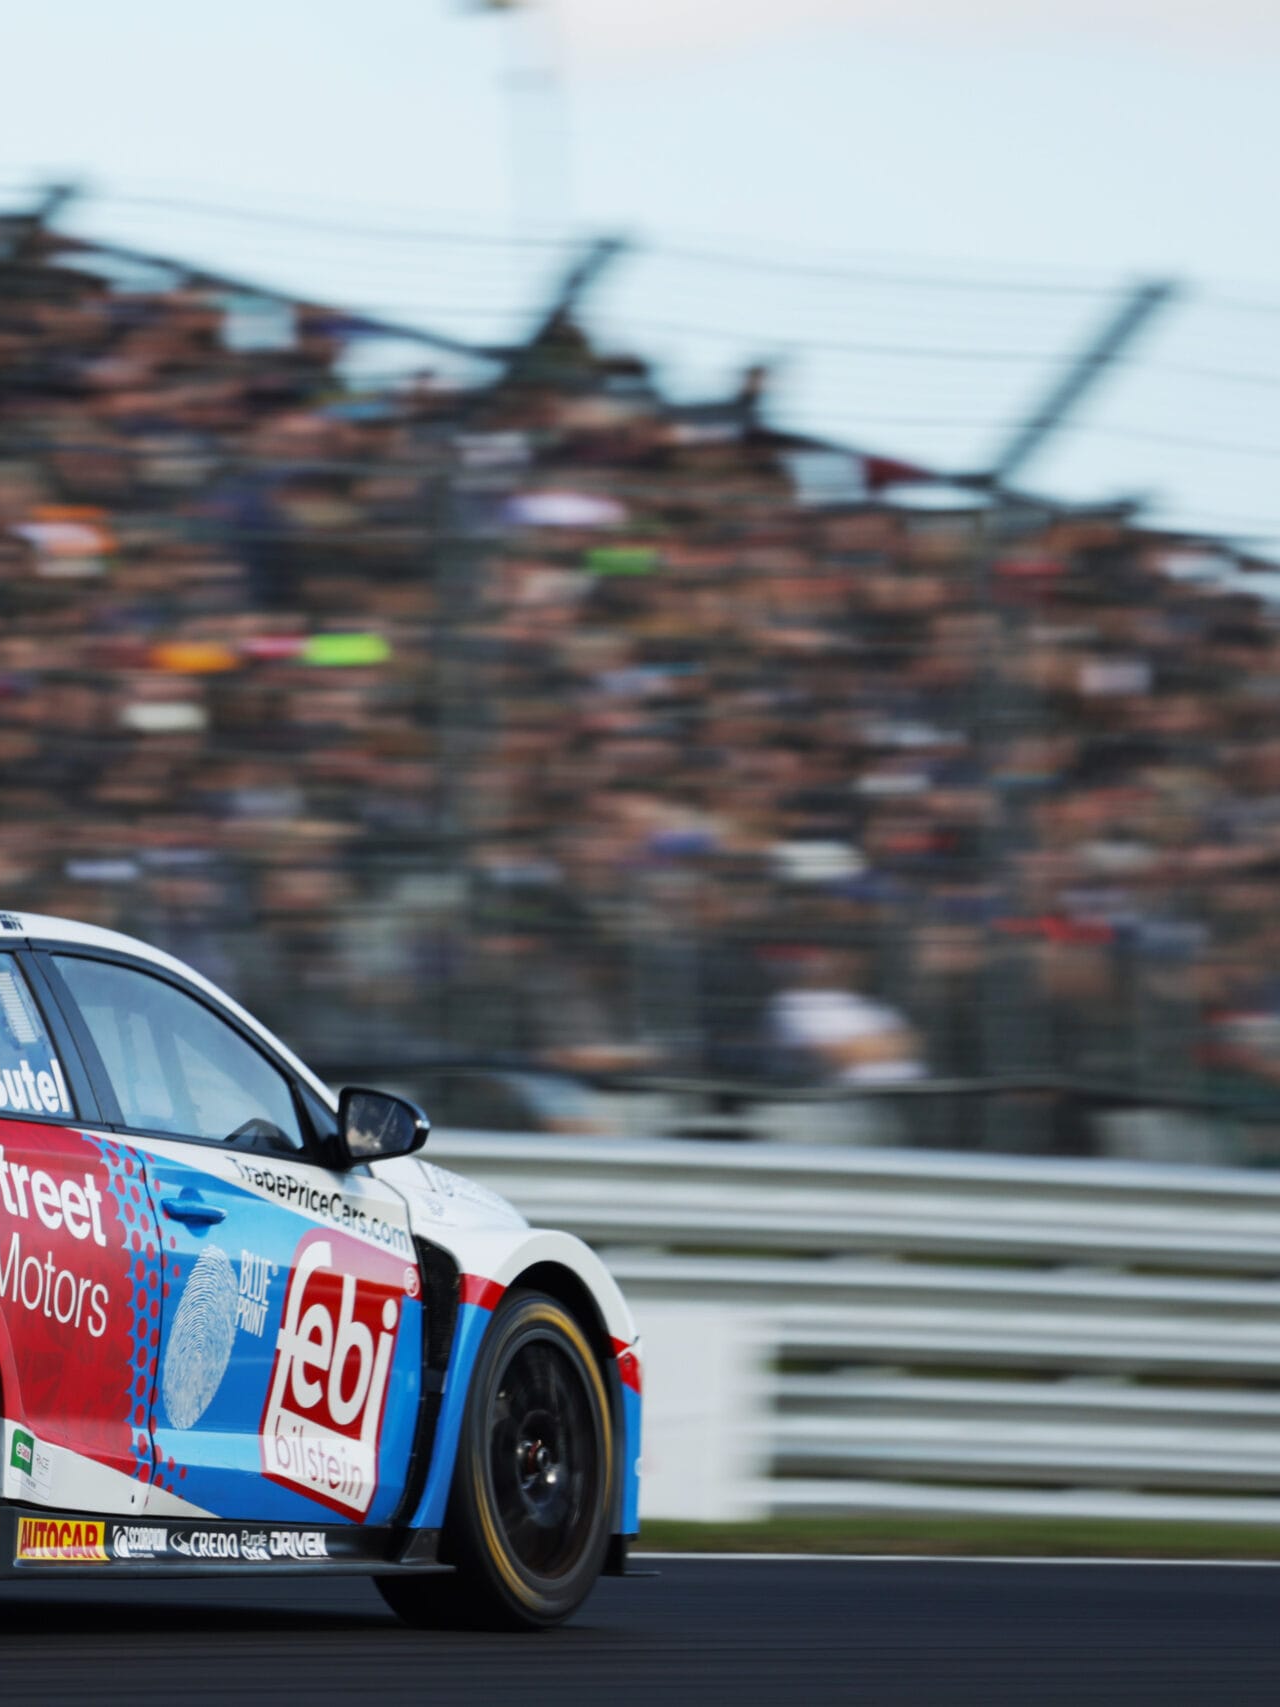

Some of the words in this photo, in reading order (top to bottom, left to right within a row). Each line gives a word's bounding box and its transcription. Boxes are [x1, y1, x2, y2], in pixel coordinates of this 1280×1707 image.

[225, 1157, 410, 1251] TradePriceCars.com
[239, 1249, 271, 1305] BLUE
[235, 1295, 269, 1338] PRINT
[275, 1240, 400, 1436] febi
[274, 1415, 364, 1500] bilstein
[20, 1521, 99, 1558] AUTOCAR
[190, 1532, 239, 1558] CREDO
[269, 1531, 328, 1556] DRIVEN
